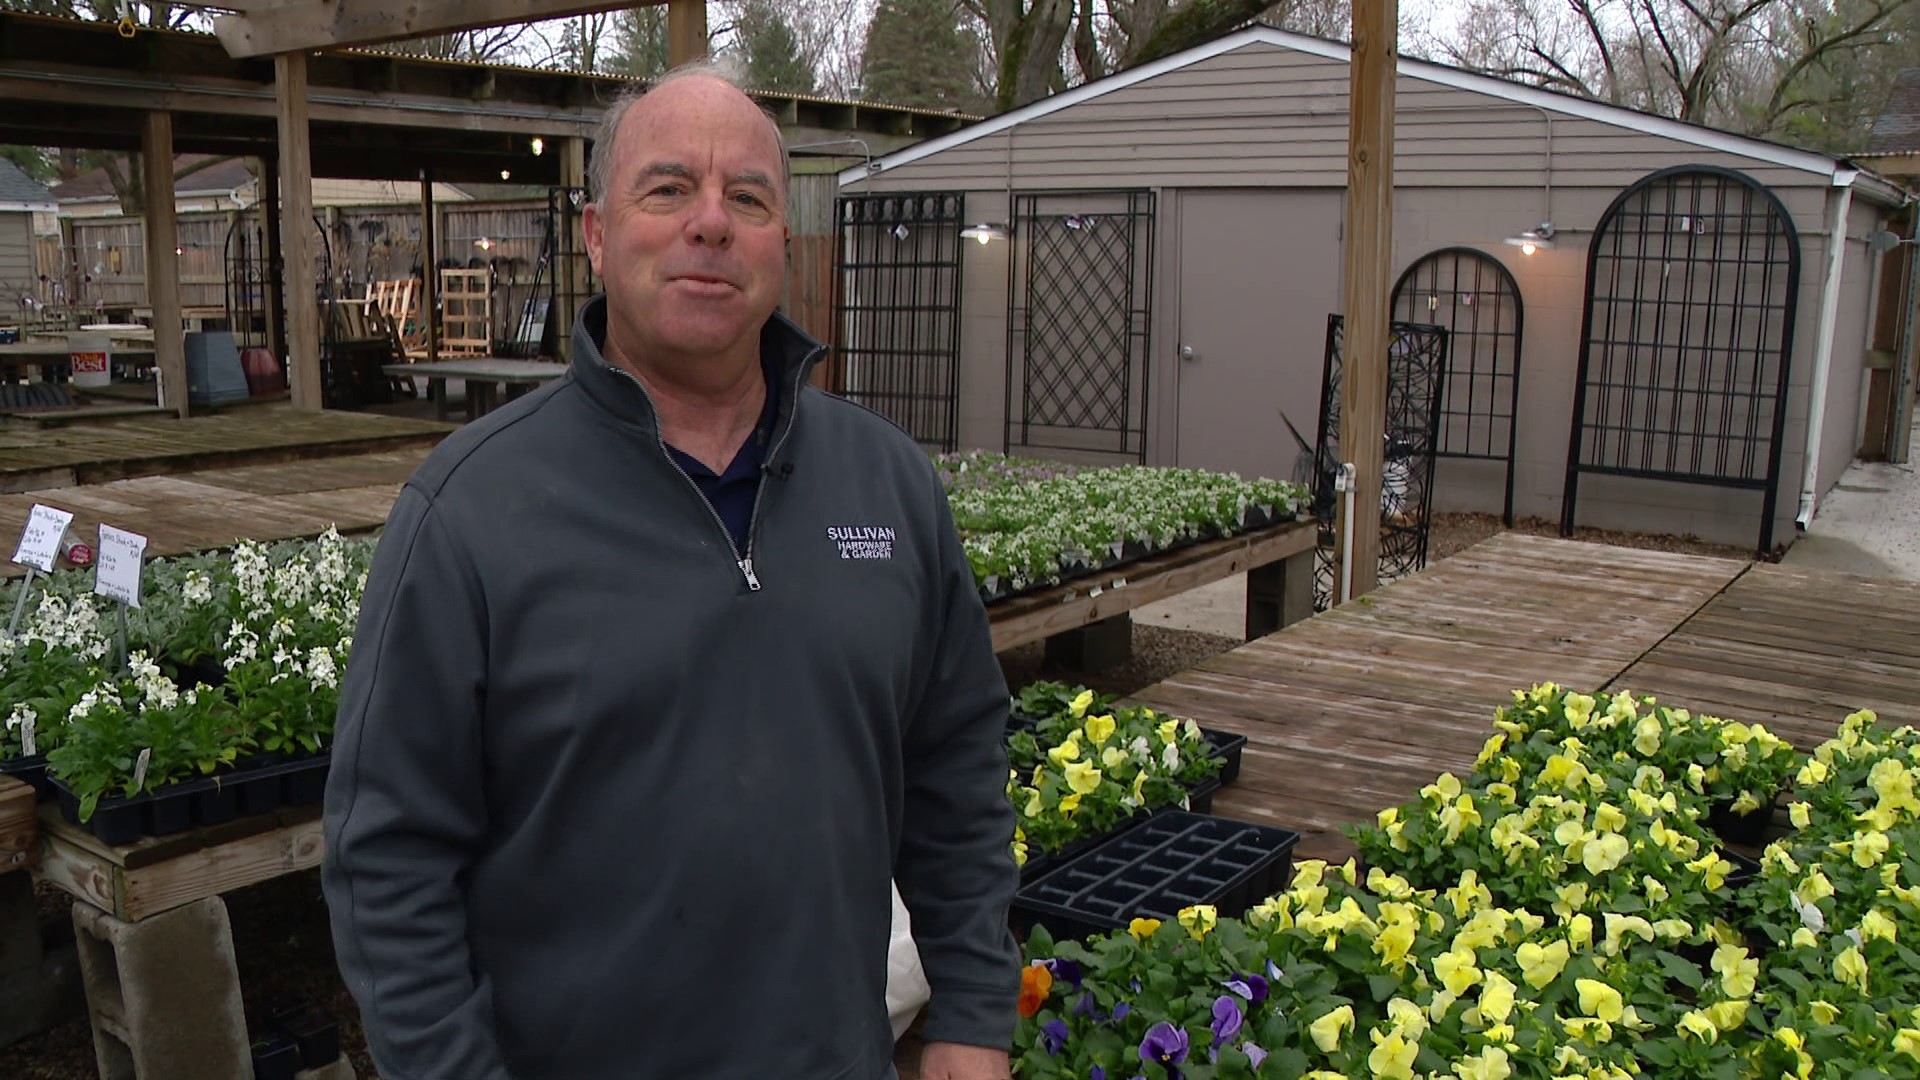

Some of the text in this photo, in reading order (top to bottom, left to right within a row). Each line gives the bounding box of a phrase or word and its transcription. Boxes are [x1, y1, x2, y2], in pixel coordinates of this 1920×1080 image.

[72, 355, 104, 371] Best
[827, 526, 896, 541] SULLIVAN
[837, 540, 893, 551] HARDWARE
[841, 550, 892, 560] & GARDEN
